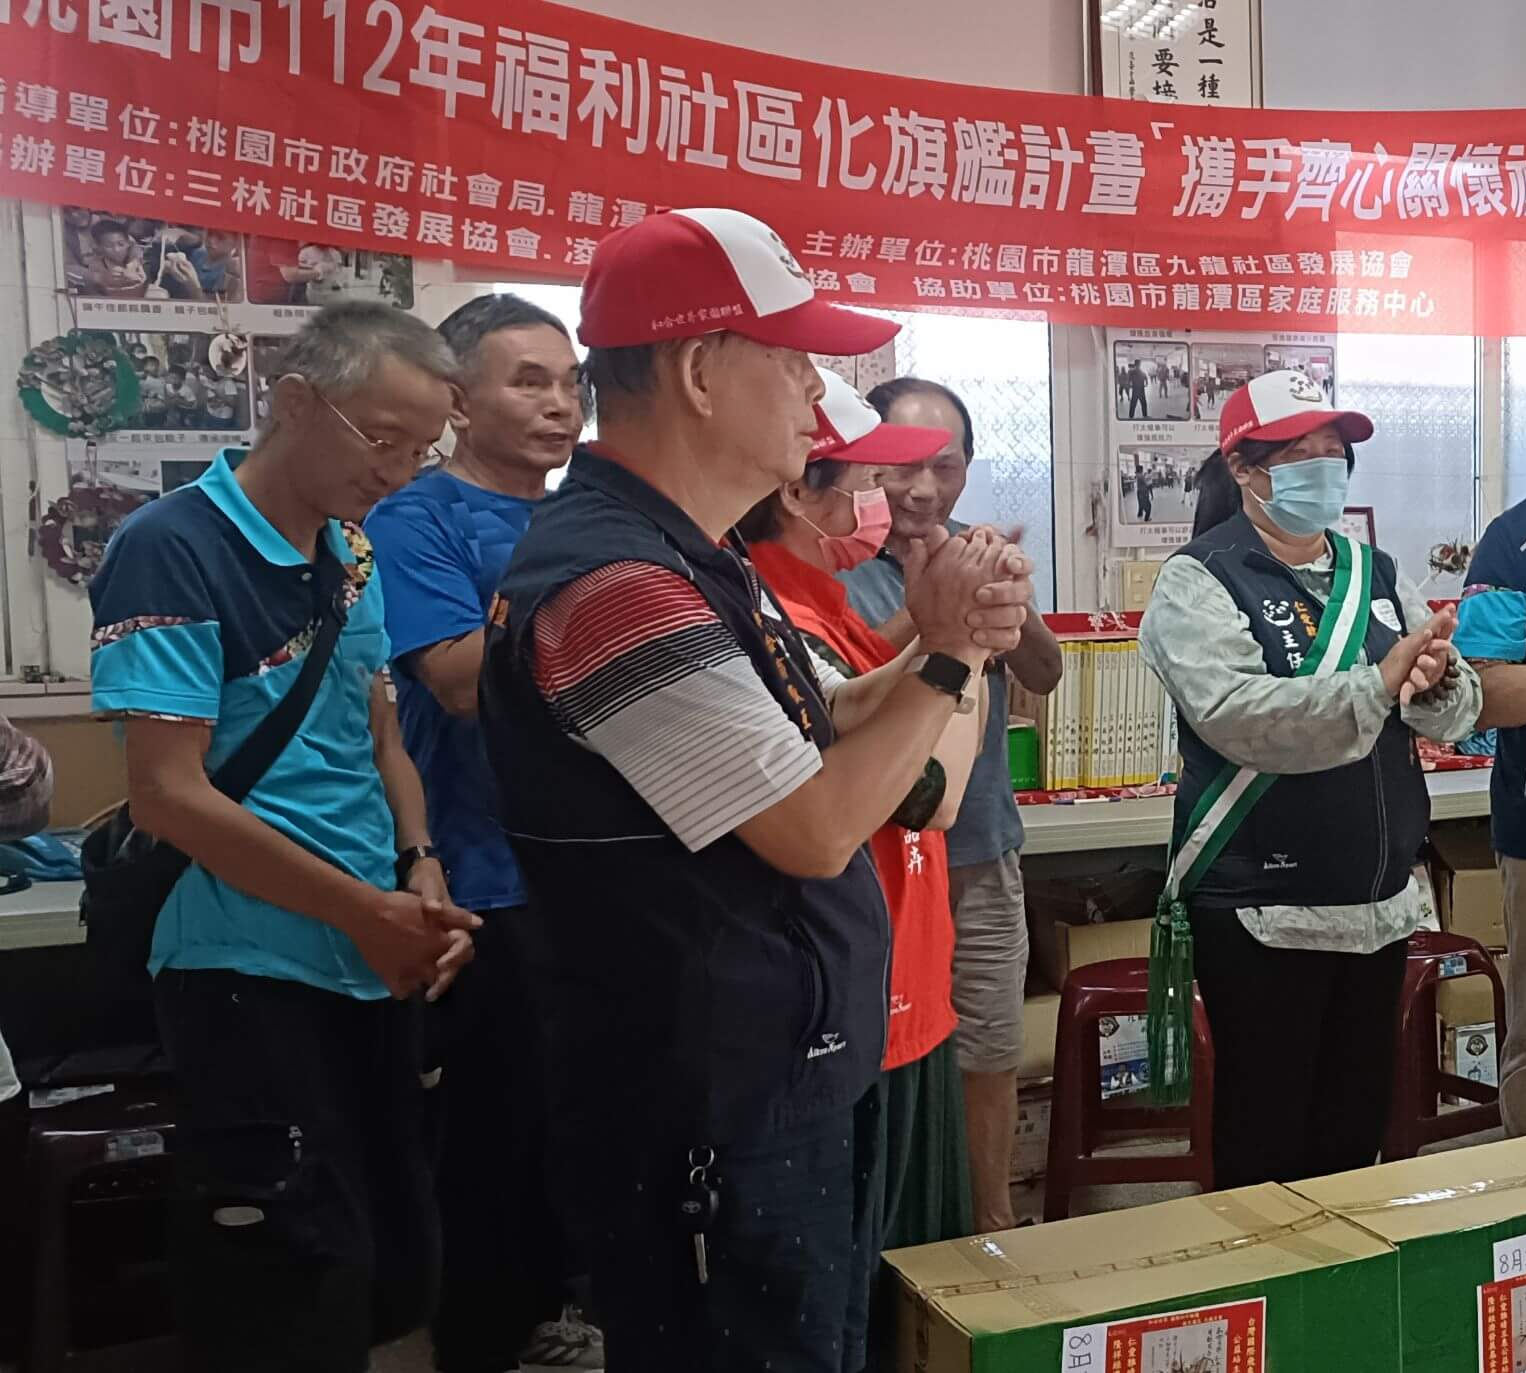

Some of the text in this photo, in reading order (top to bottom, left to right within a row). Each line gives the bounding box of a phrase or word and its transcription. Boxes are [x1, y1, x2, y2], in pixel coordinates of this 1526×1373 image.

[0, 78, 1413, 280] 導單位:桃園市政府社會局.龍潭 主辦單位:桃園市龍潭區九龍社區發展協會
[913, 277, 1435, 318] 協助單位:桃園市龍潭區家庭服務中心
[1067, 1332, 1093, 1373] 8月
